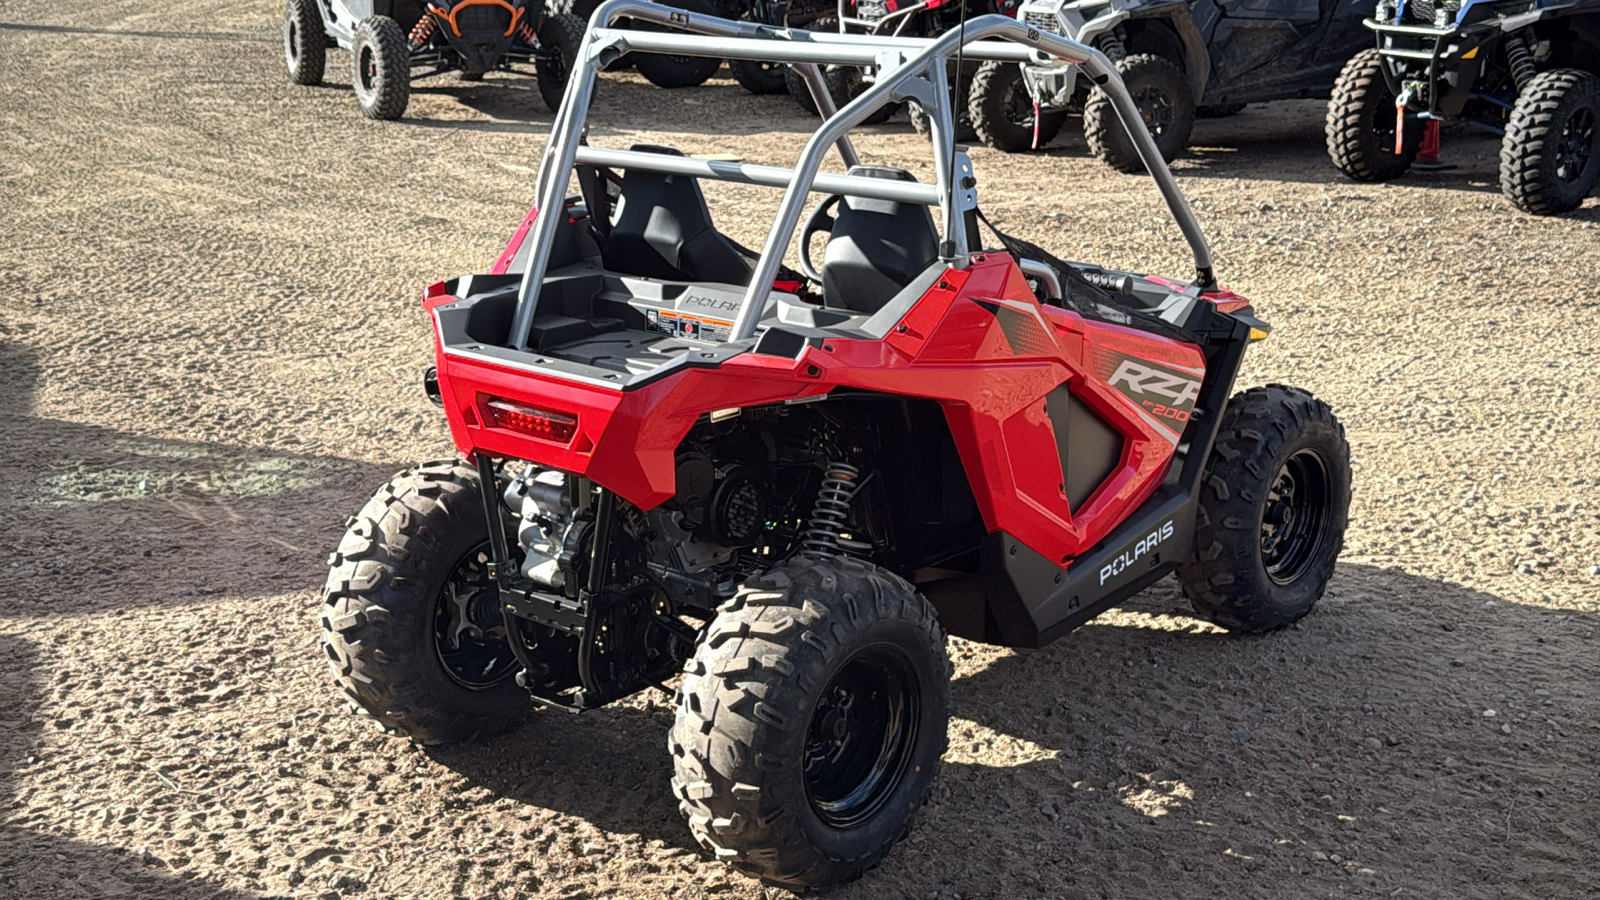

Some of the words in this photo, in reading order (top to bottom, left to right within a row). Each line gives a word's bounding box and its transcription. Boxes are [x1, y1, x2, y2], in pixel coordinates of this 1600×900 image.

[685, 295, 741, 312] POLAR
[1152, 403, 1190, 422] 200
[1100, 520, 1174, 586] POLARIS
